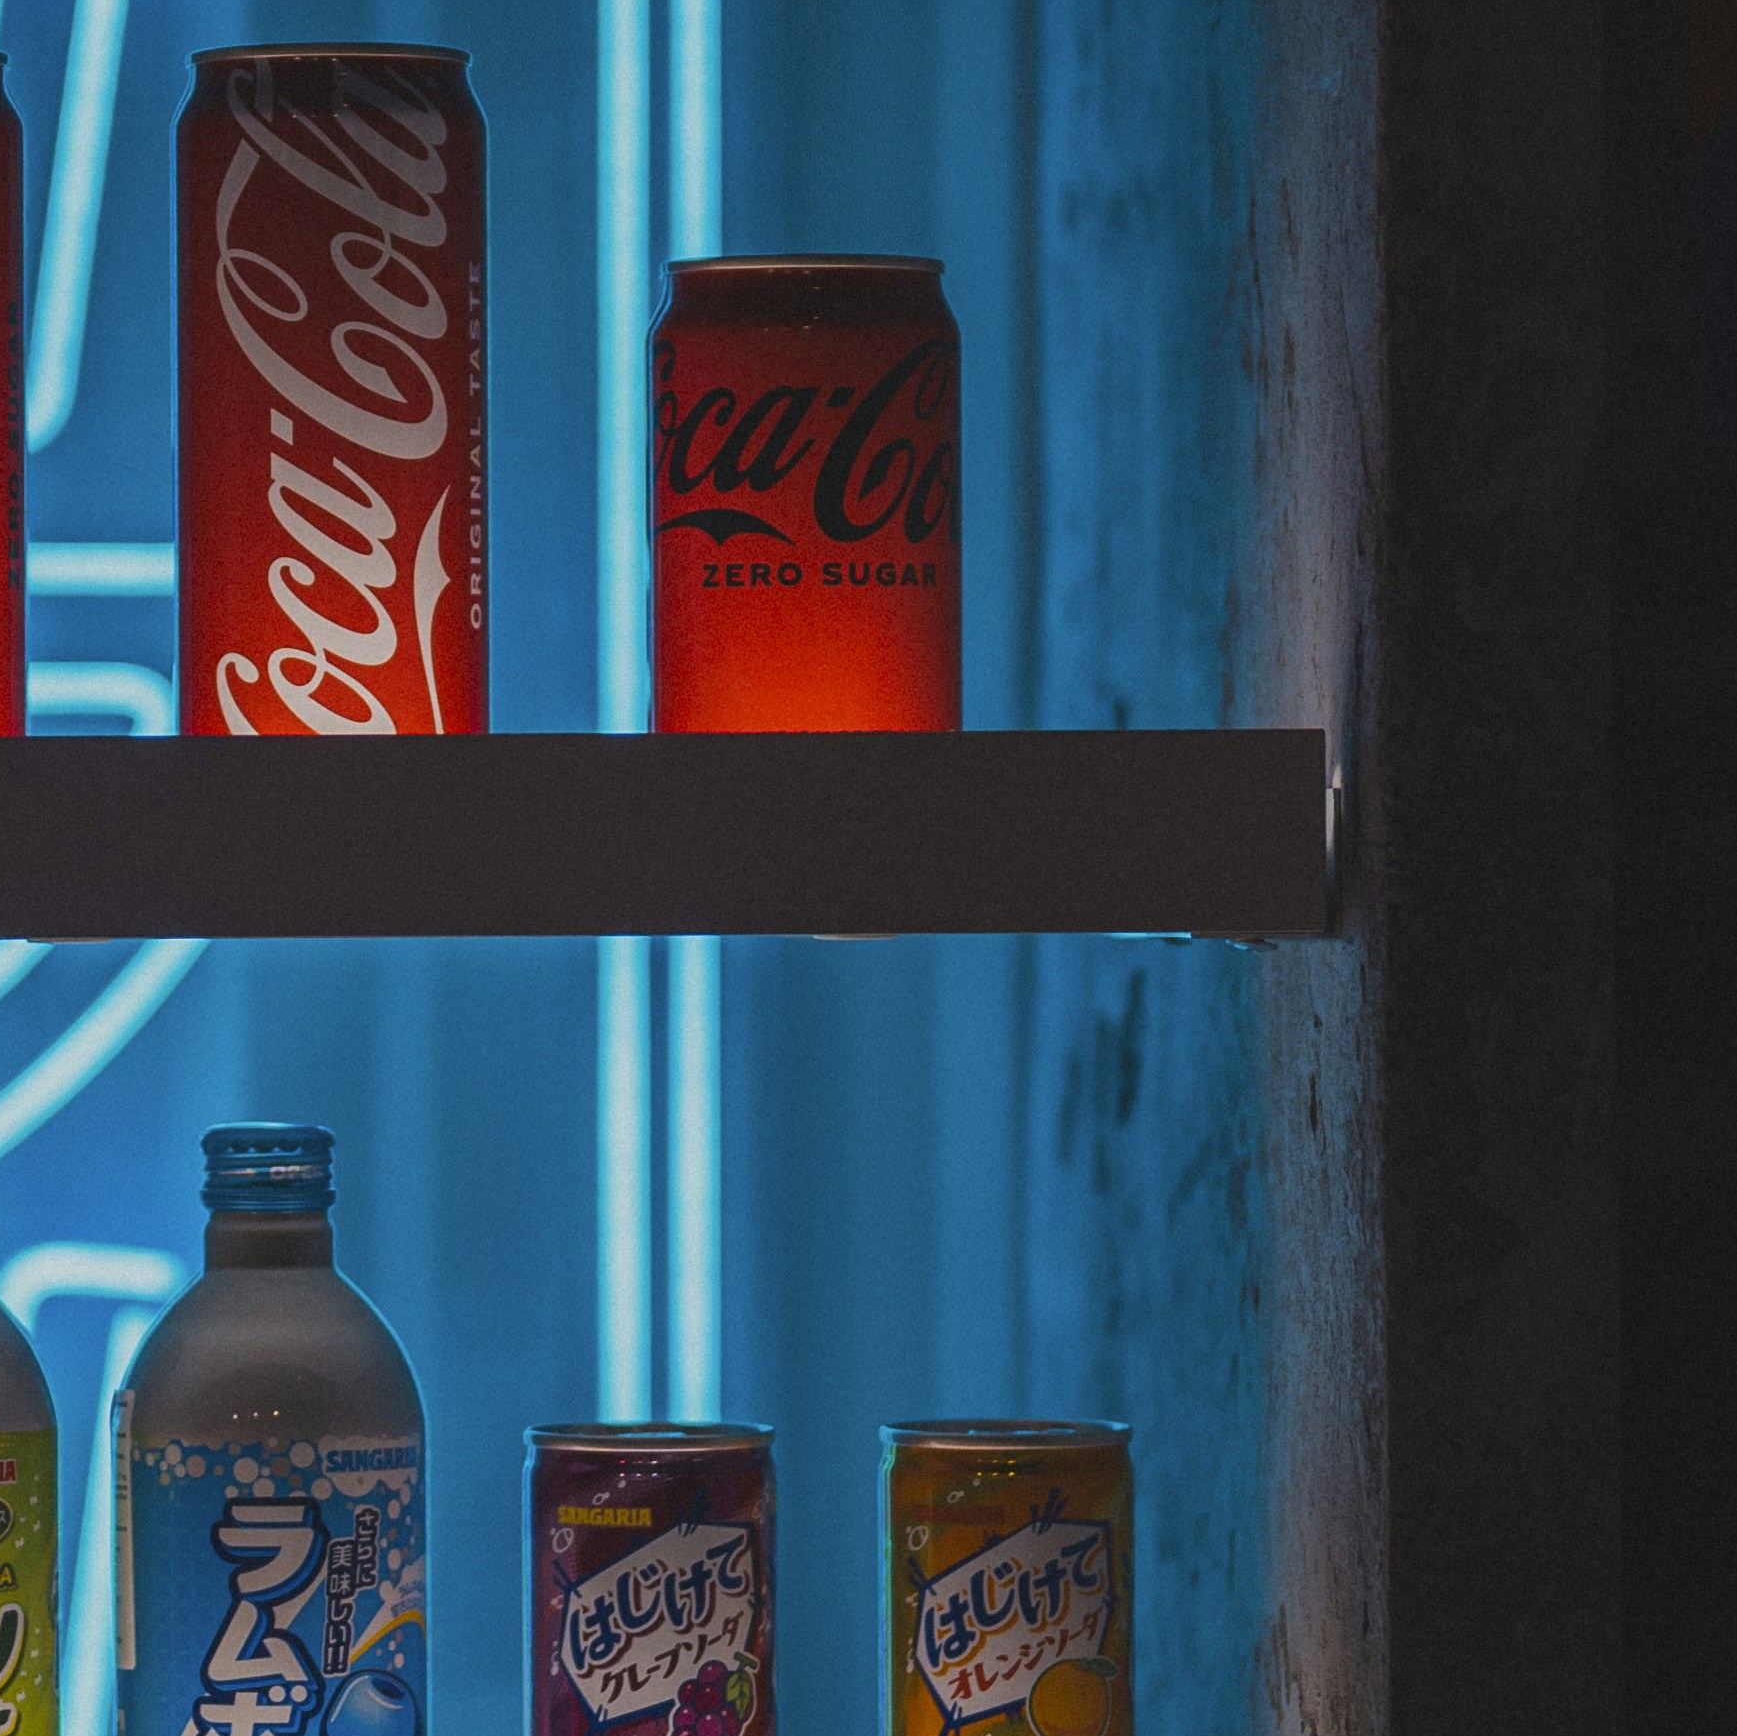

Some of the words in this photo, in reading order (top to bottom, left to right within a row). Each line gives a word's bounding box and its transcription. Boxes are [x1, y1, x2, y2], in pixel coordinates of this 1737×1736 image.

[468, 262, 482, 391] TASTE
[468, 415, 483, 629] ORIGINAL
[703, 563, 802, 588] ZERO
[822, 562, 938, 586] SUGAR
[357, 1508, 378, 1586] さらに
[570, 1533, 746, 1672] はじけて
[925, 1533, 1100, 1668] はじけて
[600, 1610, 745, 1704] グレープソーダ
[947, 1607, 1104, 1701] オレンジソーダ
